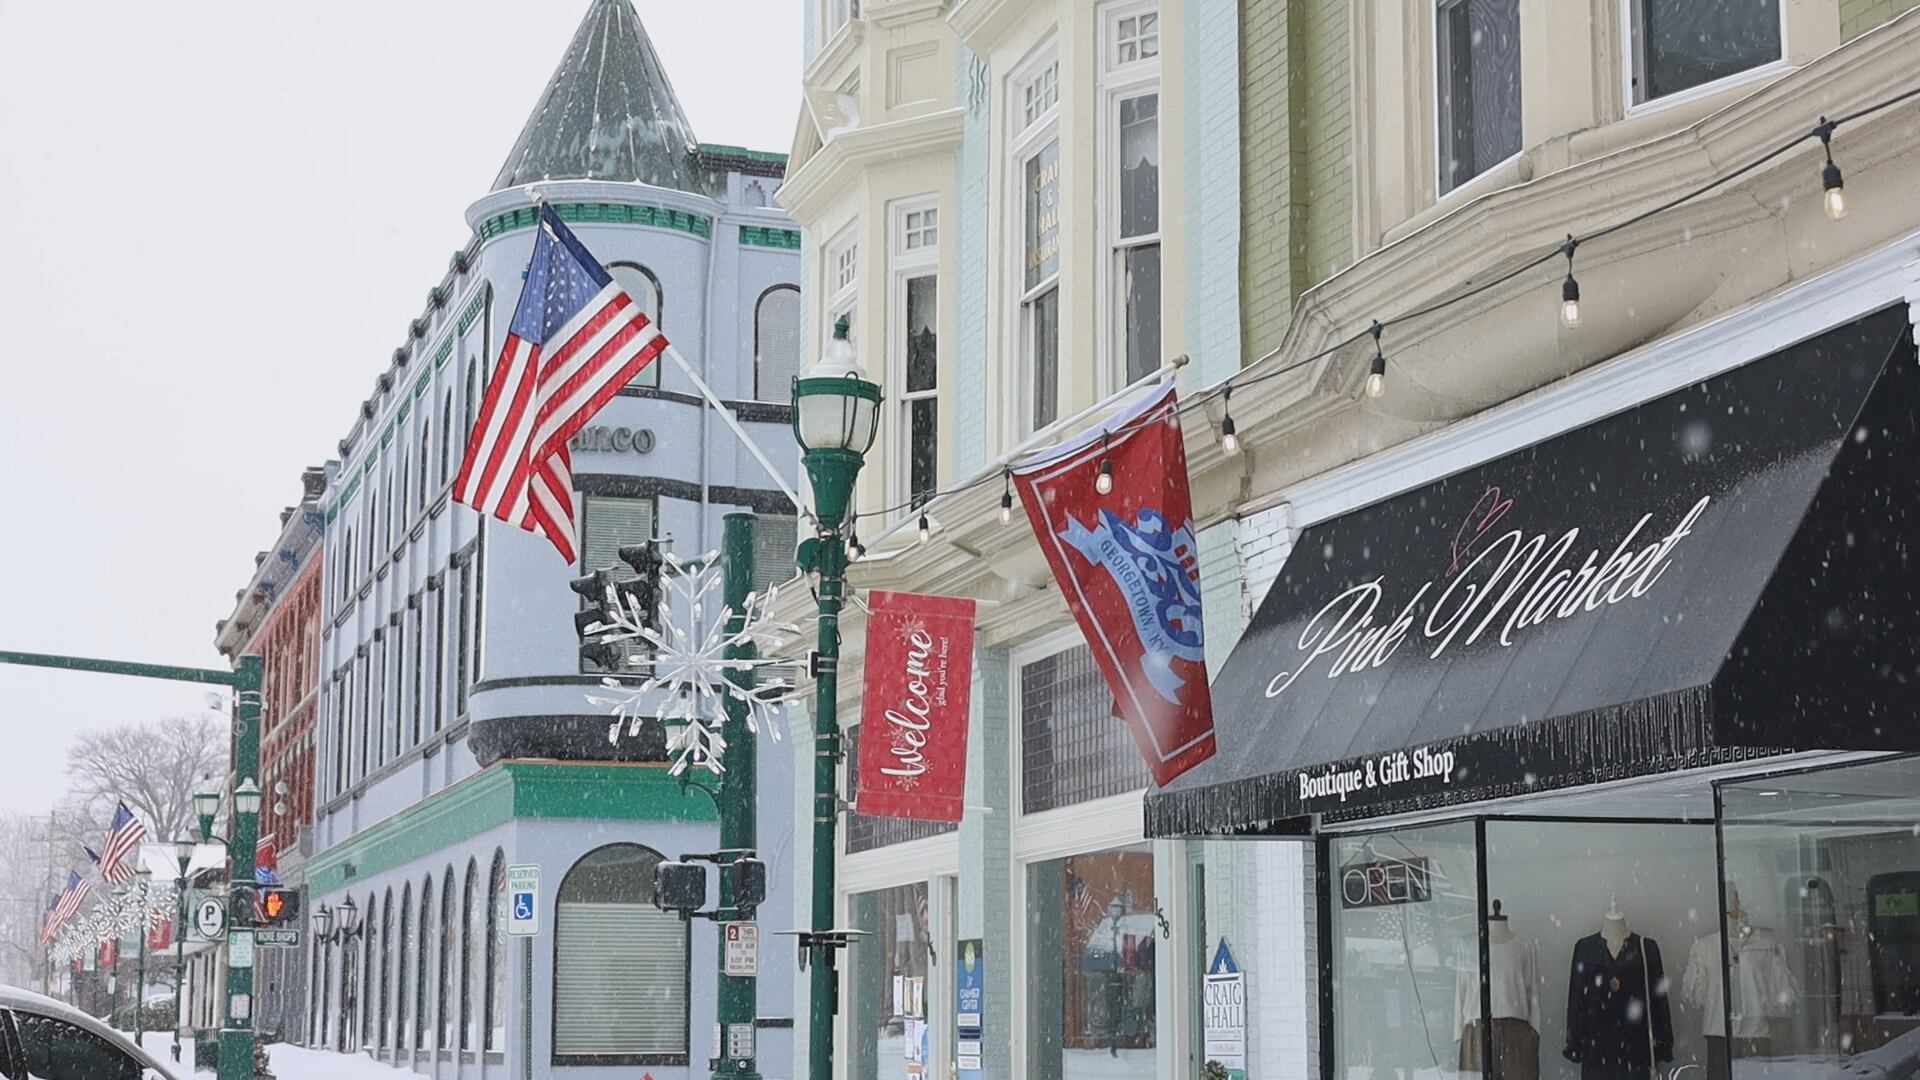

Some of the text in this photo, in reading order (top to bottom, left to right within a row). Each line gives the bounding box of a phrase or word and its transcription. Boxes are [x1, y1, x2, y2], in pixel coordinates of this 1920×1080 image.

[1033, 160, 1058, 193] CRAI
[1039, 208, 1059, 234] HAL
[1101, 540, 1170, 652] GEORGETOWN, KY
[1265, 495, 1710, 698] Pink Market
[936, 637, 949, 706] glad you're here!
[880, 629, 933, 776] Welcome
[1299, 747, 1454, 802] Boutique & Gift Shop
[1343, 861, 1428, 905] OPEN
[205, 905, 215, 920] P
[730, 929, 737, 940] 2
[1204, 982, 1242, 1006] CRAIG
[1211, 1006, 1243, 1028] HALL
